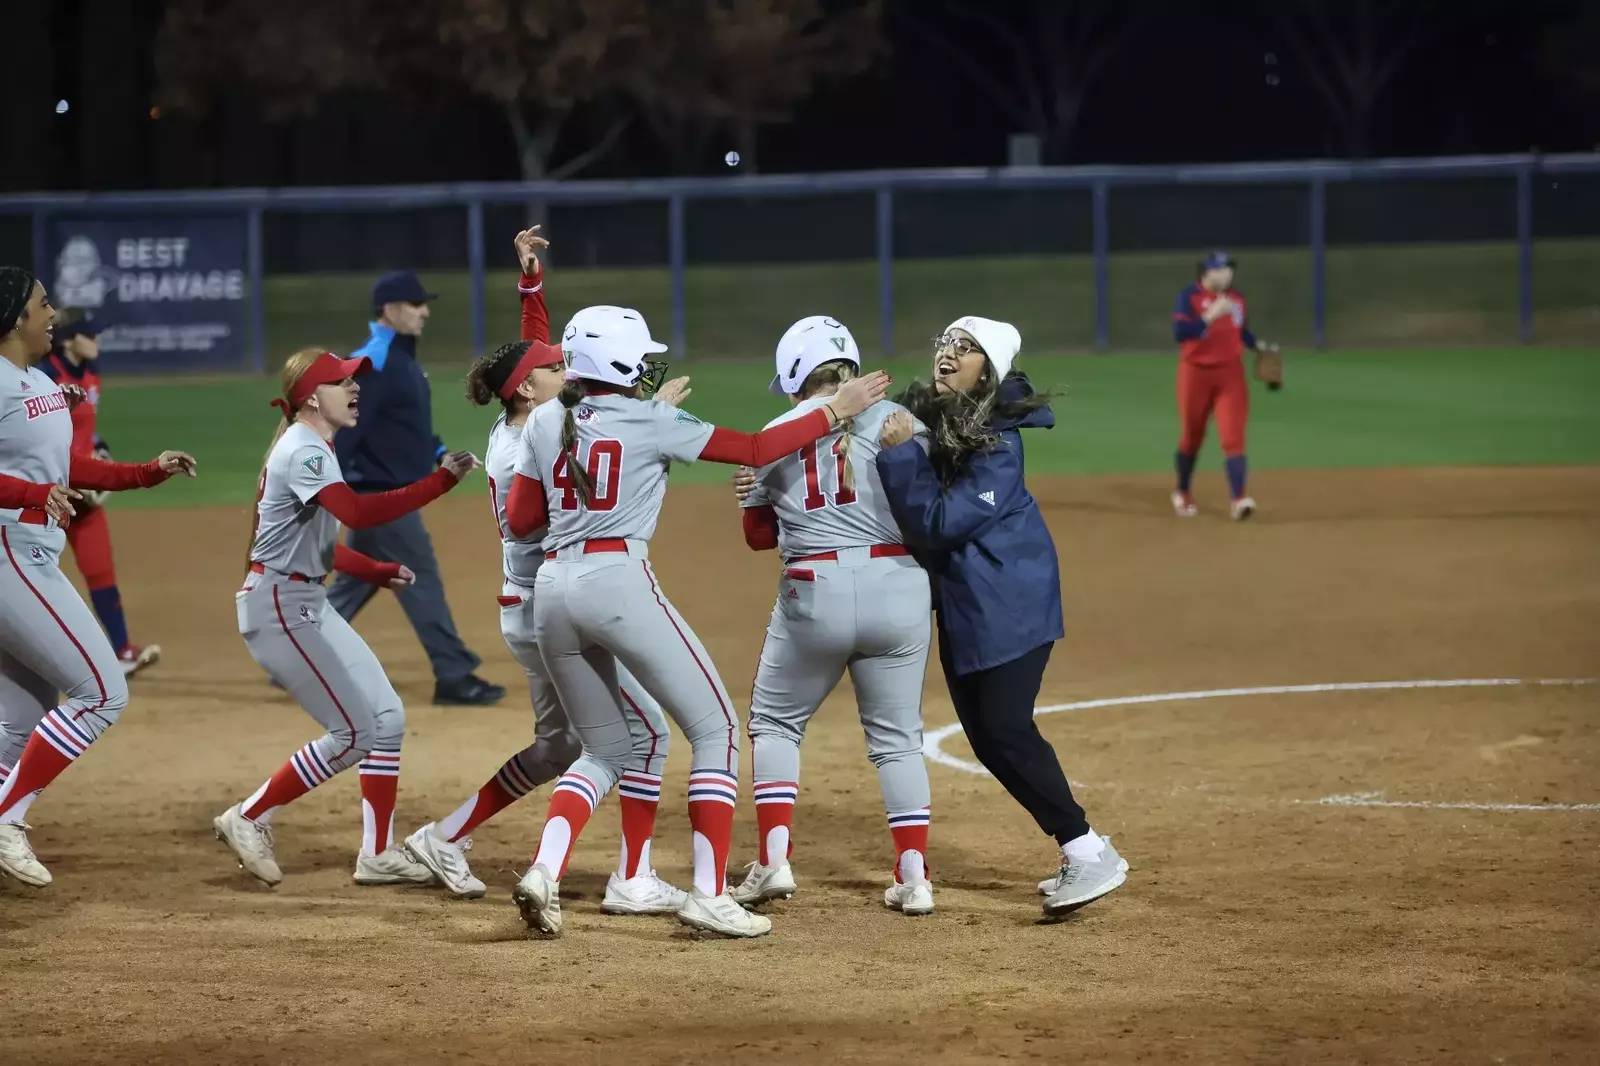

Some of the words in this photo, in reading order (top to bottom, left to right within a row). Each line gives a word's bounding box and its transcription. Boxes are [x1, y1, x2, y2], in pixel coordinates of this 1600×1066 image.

[117, 238, 188, 267] BEST
[118, 270, 243, 299] DRAYAGE
[552, 438, 624, 512] 40
[798, 433, 858, 513] 11
